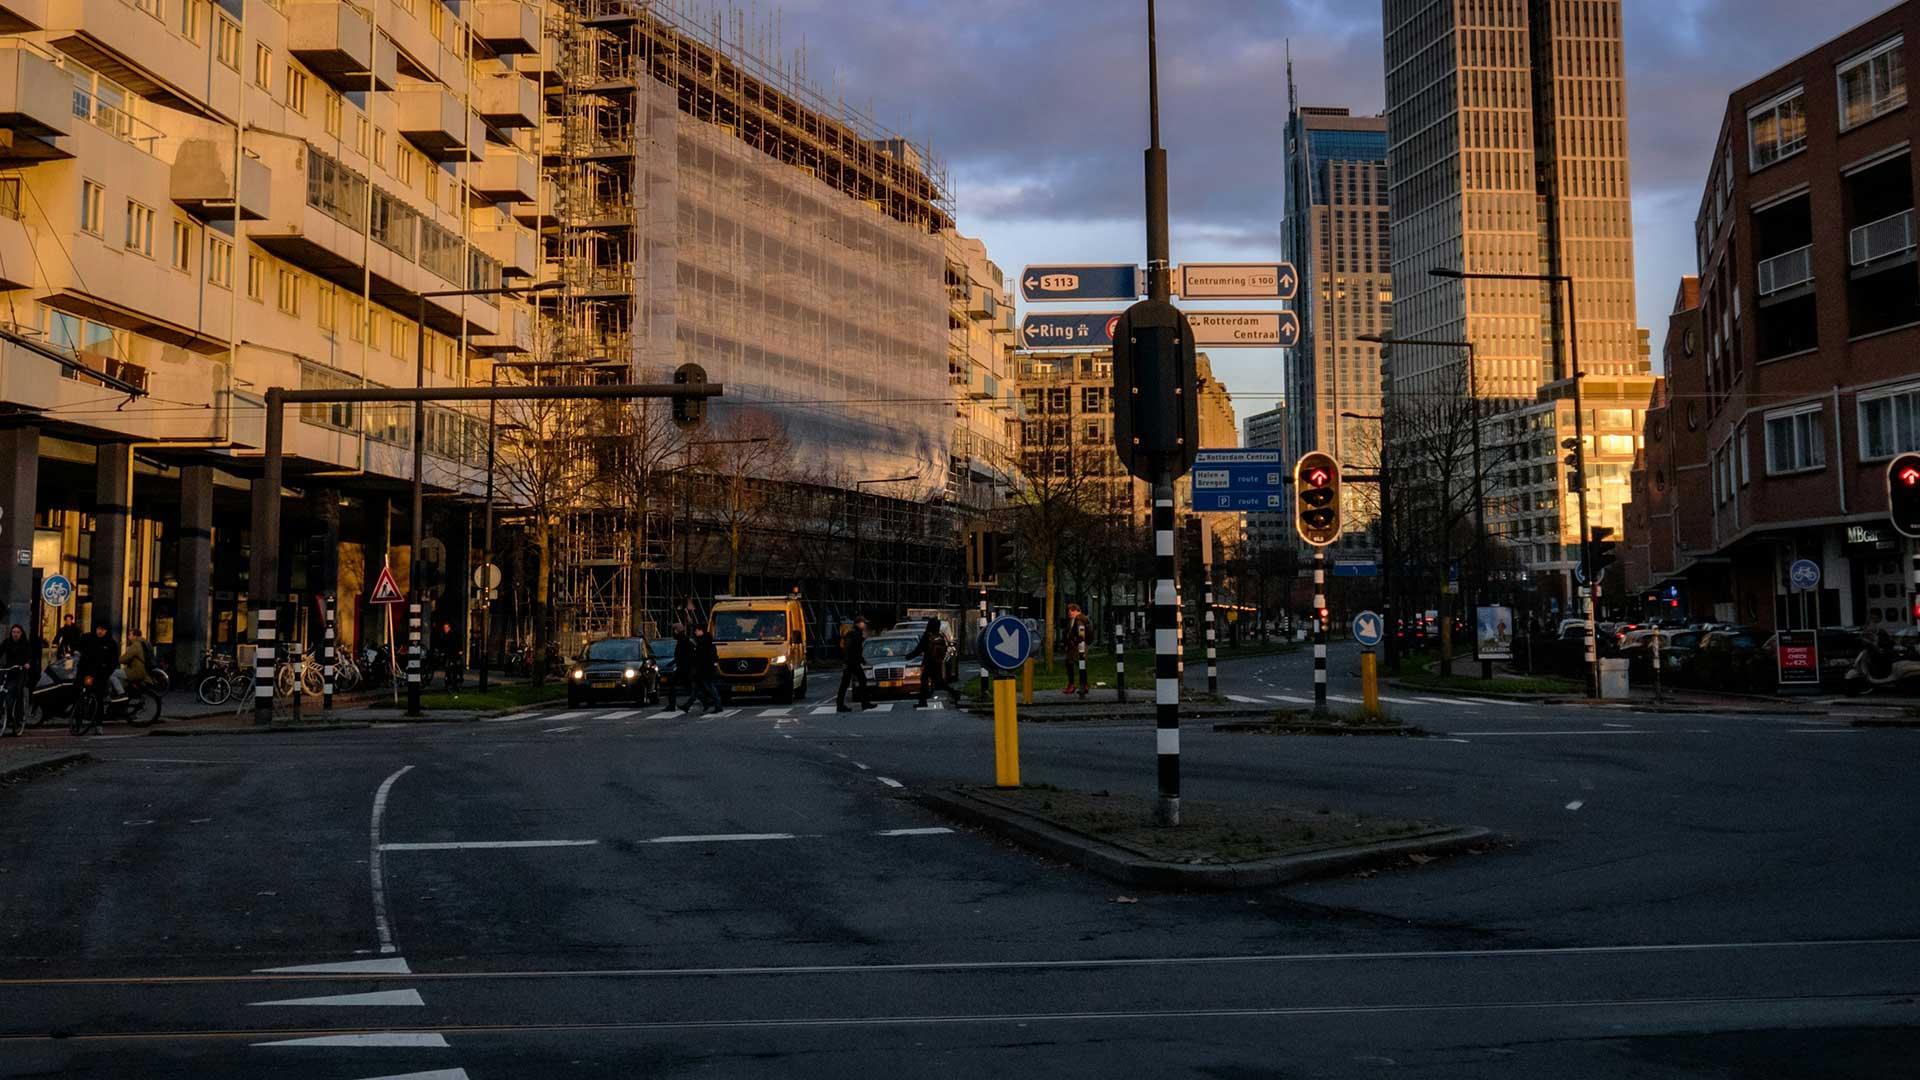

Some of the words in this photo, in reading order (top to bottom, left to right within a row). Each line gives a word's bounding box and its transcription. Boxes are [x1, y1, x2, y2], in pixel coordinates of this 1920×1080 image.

[1044, 277, 1051, 287] S
[1054, 277, 1074, 287] 113
[1188, 276, 1246, 286] Centrumring
[1203, 316, 1259, 326] Rotterdam
[1040, 324, 1073, 339] Ring
[1233, 330, 1278, 339] Centraal
